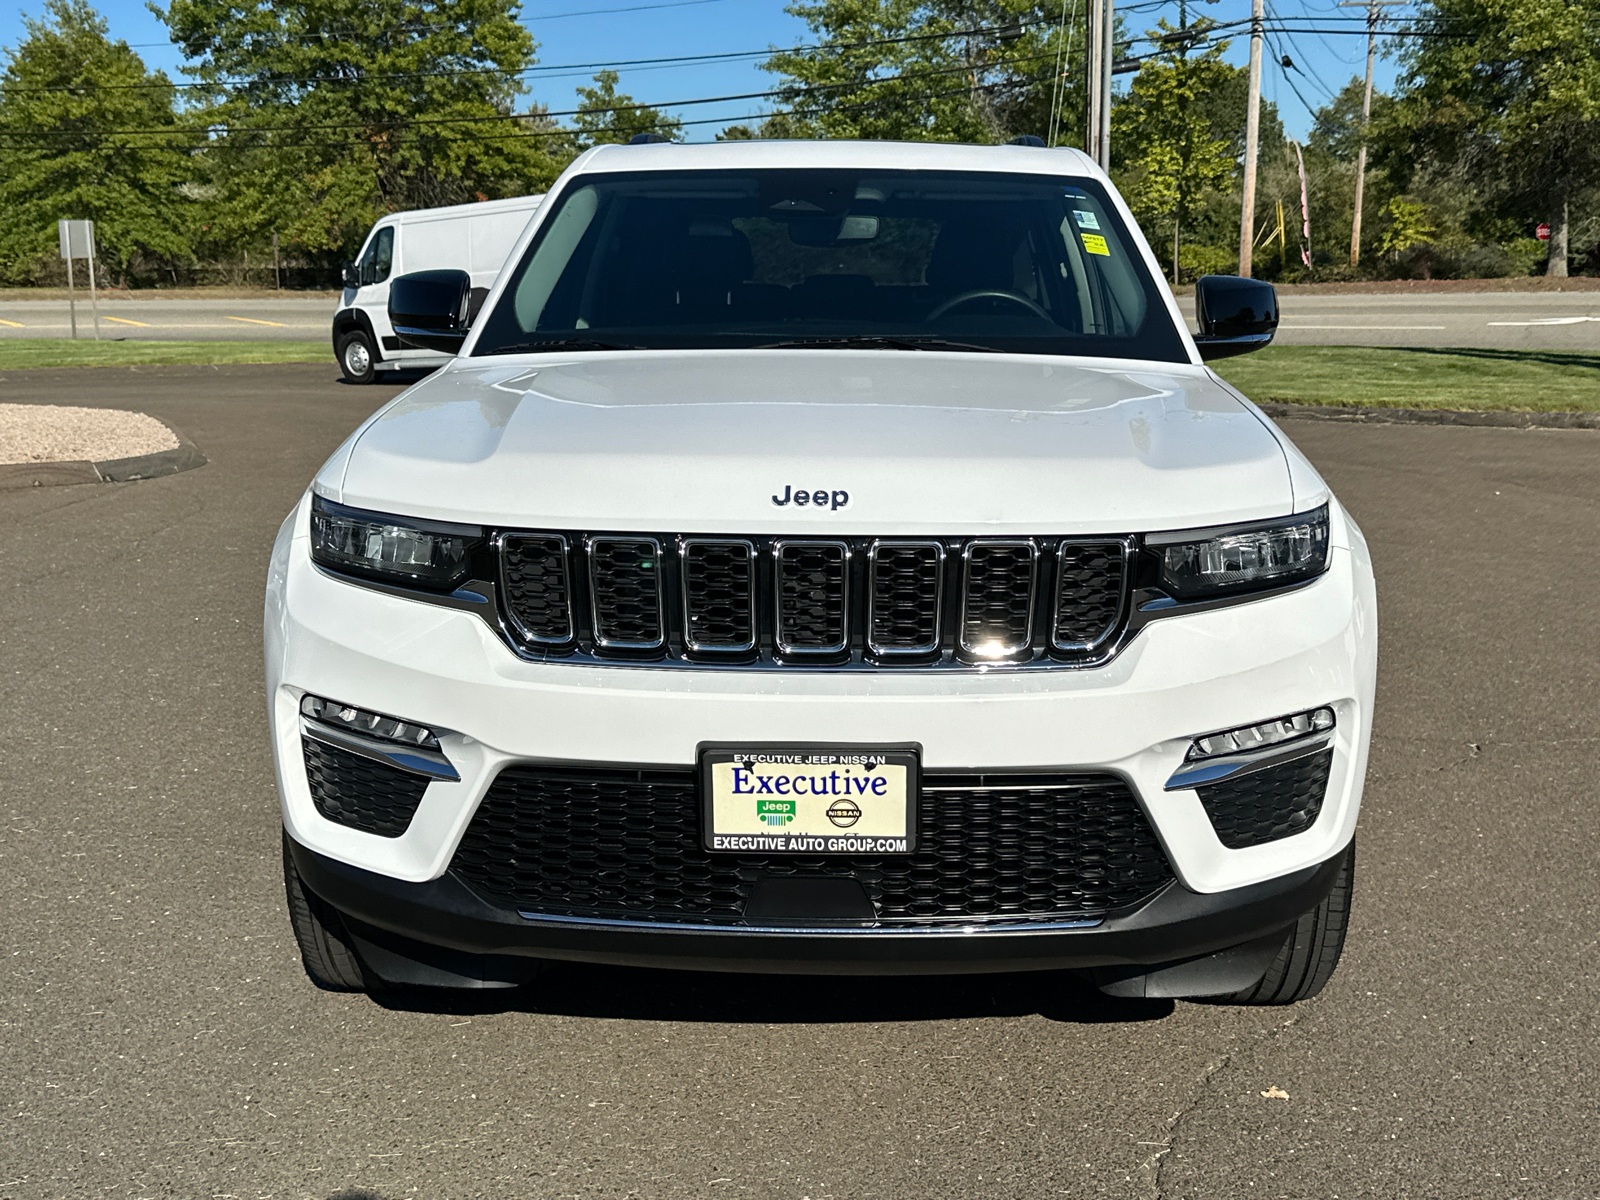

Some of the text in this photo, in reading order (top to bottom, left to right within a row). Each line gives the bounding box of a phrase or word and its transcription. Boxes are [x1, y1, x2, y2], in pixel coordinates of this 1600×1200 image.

[771, 484, 849, 511] Jeep
[733, 754, 886, 765] EXECUTIVE JEEP NISSAN
[731, 767, 888, 796] Executive
[762, 801, 791, 813] Jeep
[713, 836, 907, 852] EXECUTIVE AUTO GROUP.COM
